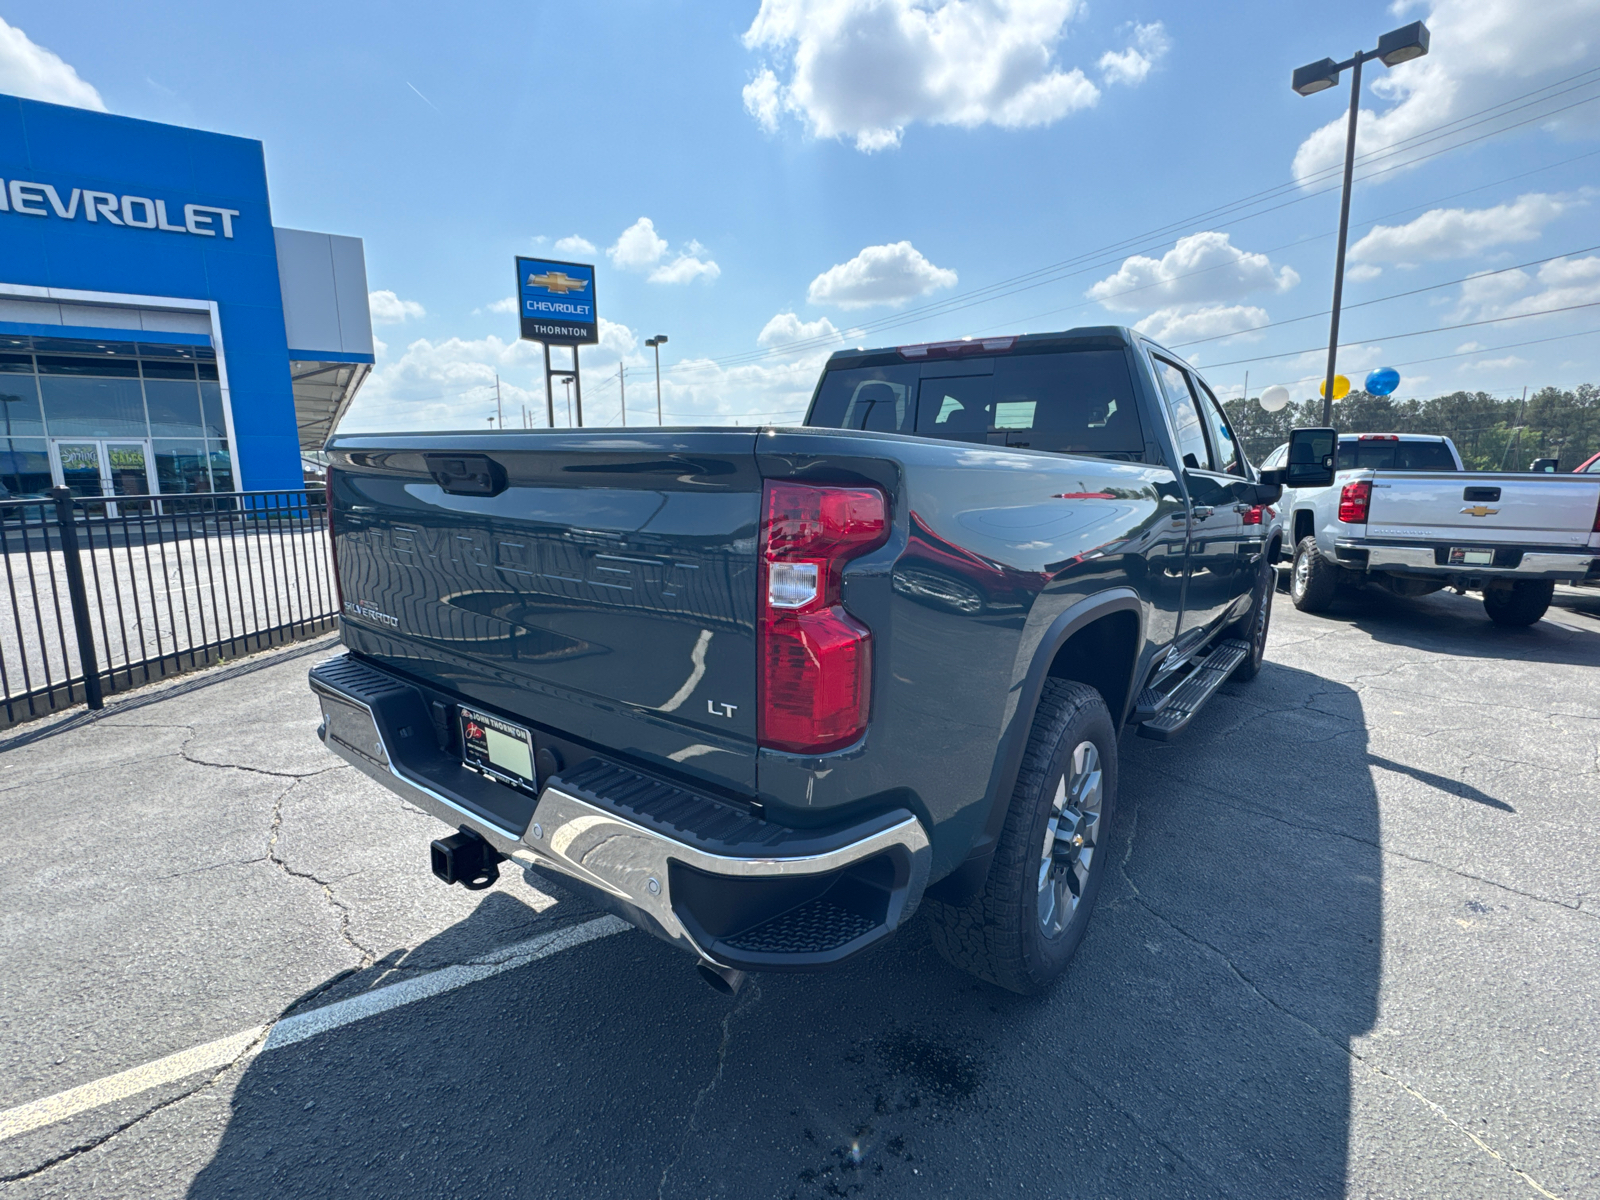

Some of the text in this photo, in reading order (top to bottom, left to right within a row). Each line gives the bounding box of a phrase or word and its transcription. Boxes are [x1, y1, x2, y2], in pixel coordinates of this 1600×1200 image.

[526, 300, 590, 315] CHEVROLET
[534, 325, 587, 336] THORNTON
[61, 448, 97, 464] Spring
[344, 601, 398, 627] SILVERADO
[708, 700, 737, 718] LT
[472, 713, 490, 725] JOHN
[490, 719, 526, 739] THORNTON
